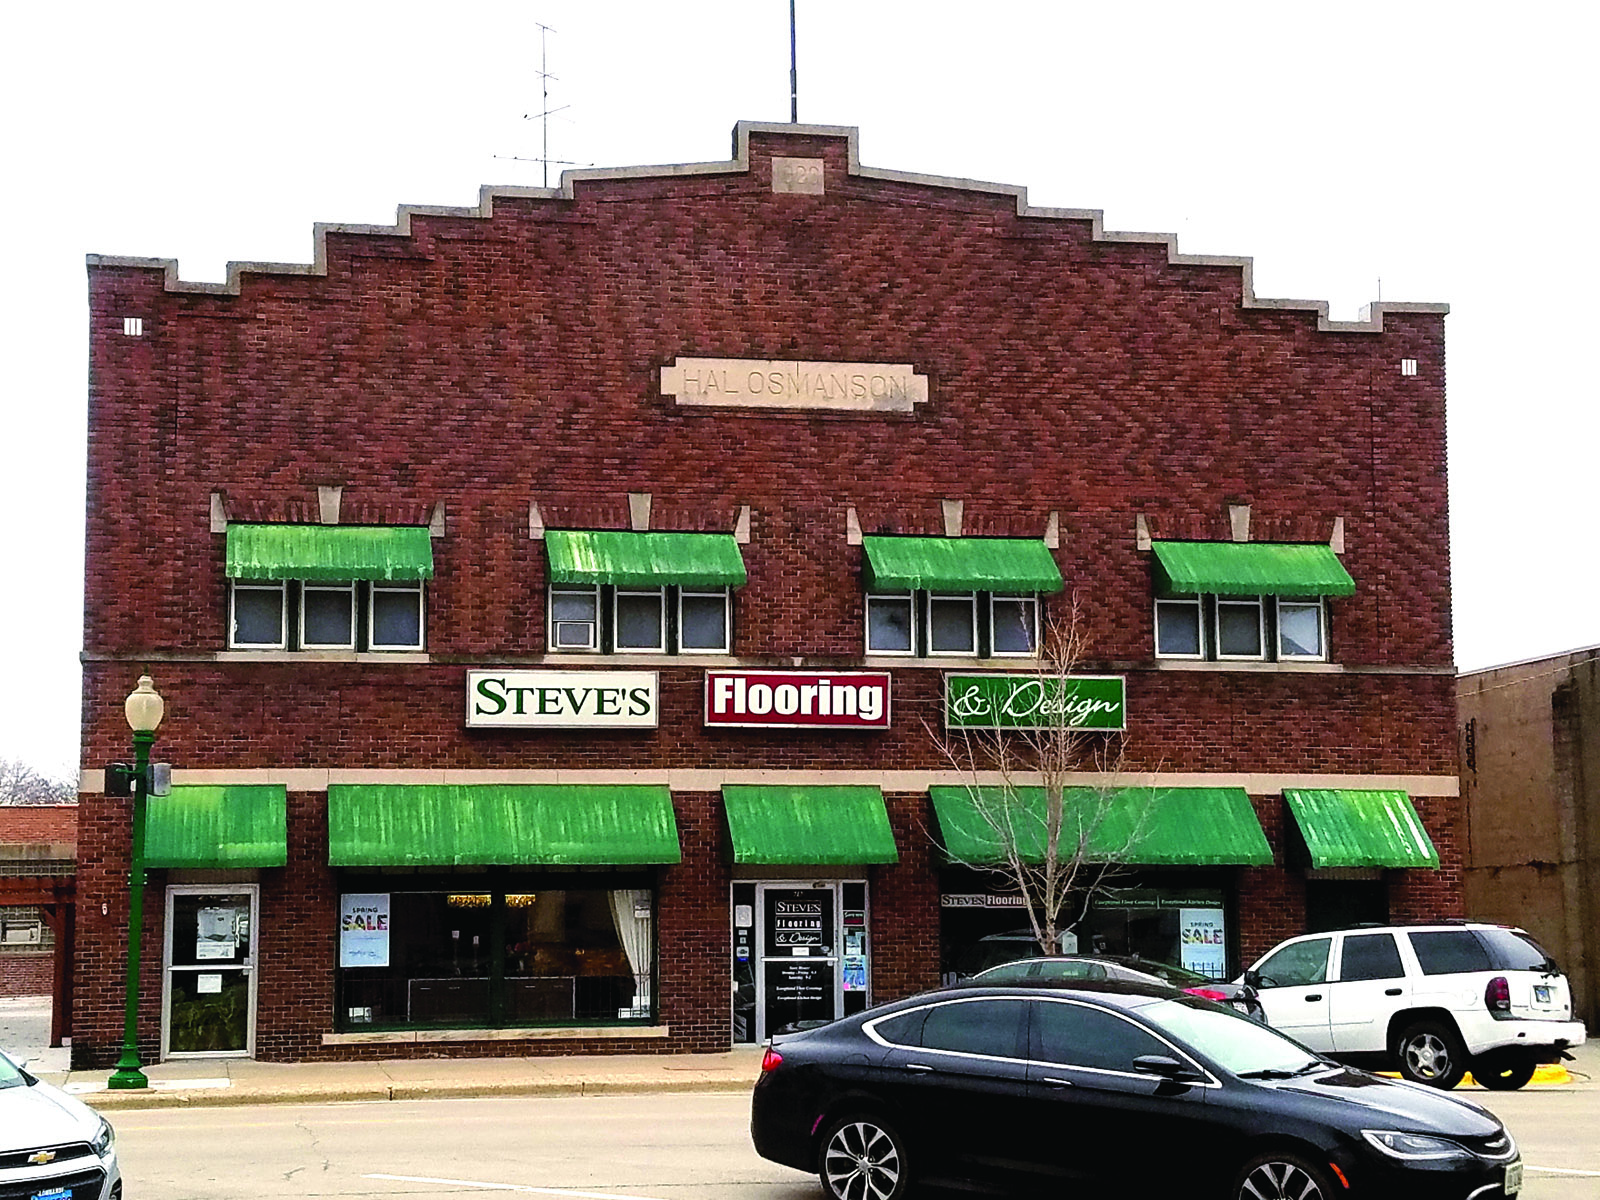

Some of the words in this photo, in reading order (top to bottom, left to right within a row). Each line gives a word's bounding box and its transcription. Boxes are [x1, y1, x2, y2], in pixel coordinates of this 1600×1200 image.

[683, 369, 738, 394] HAL
[748, 371, 908, 400] OSMANSON
[475, 678, 651, 717] STEVE'S
[714, 677, 883, 721] Flooring
[953, 685, 991, 716] &
[342, 914, 388, 931] SALE
[777, 919, 821, 929] Flooring
[1182, 928, 1223, 945] SALE
